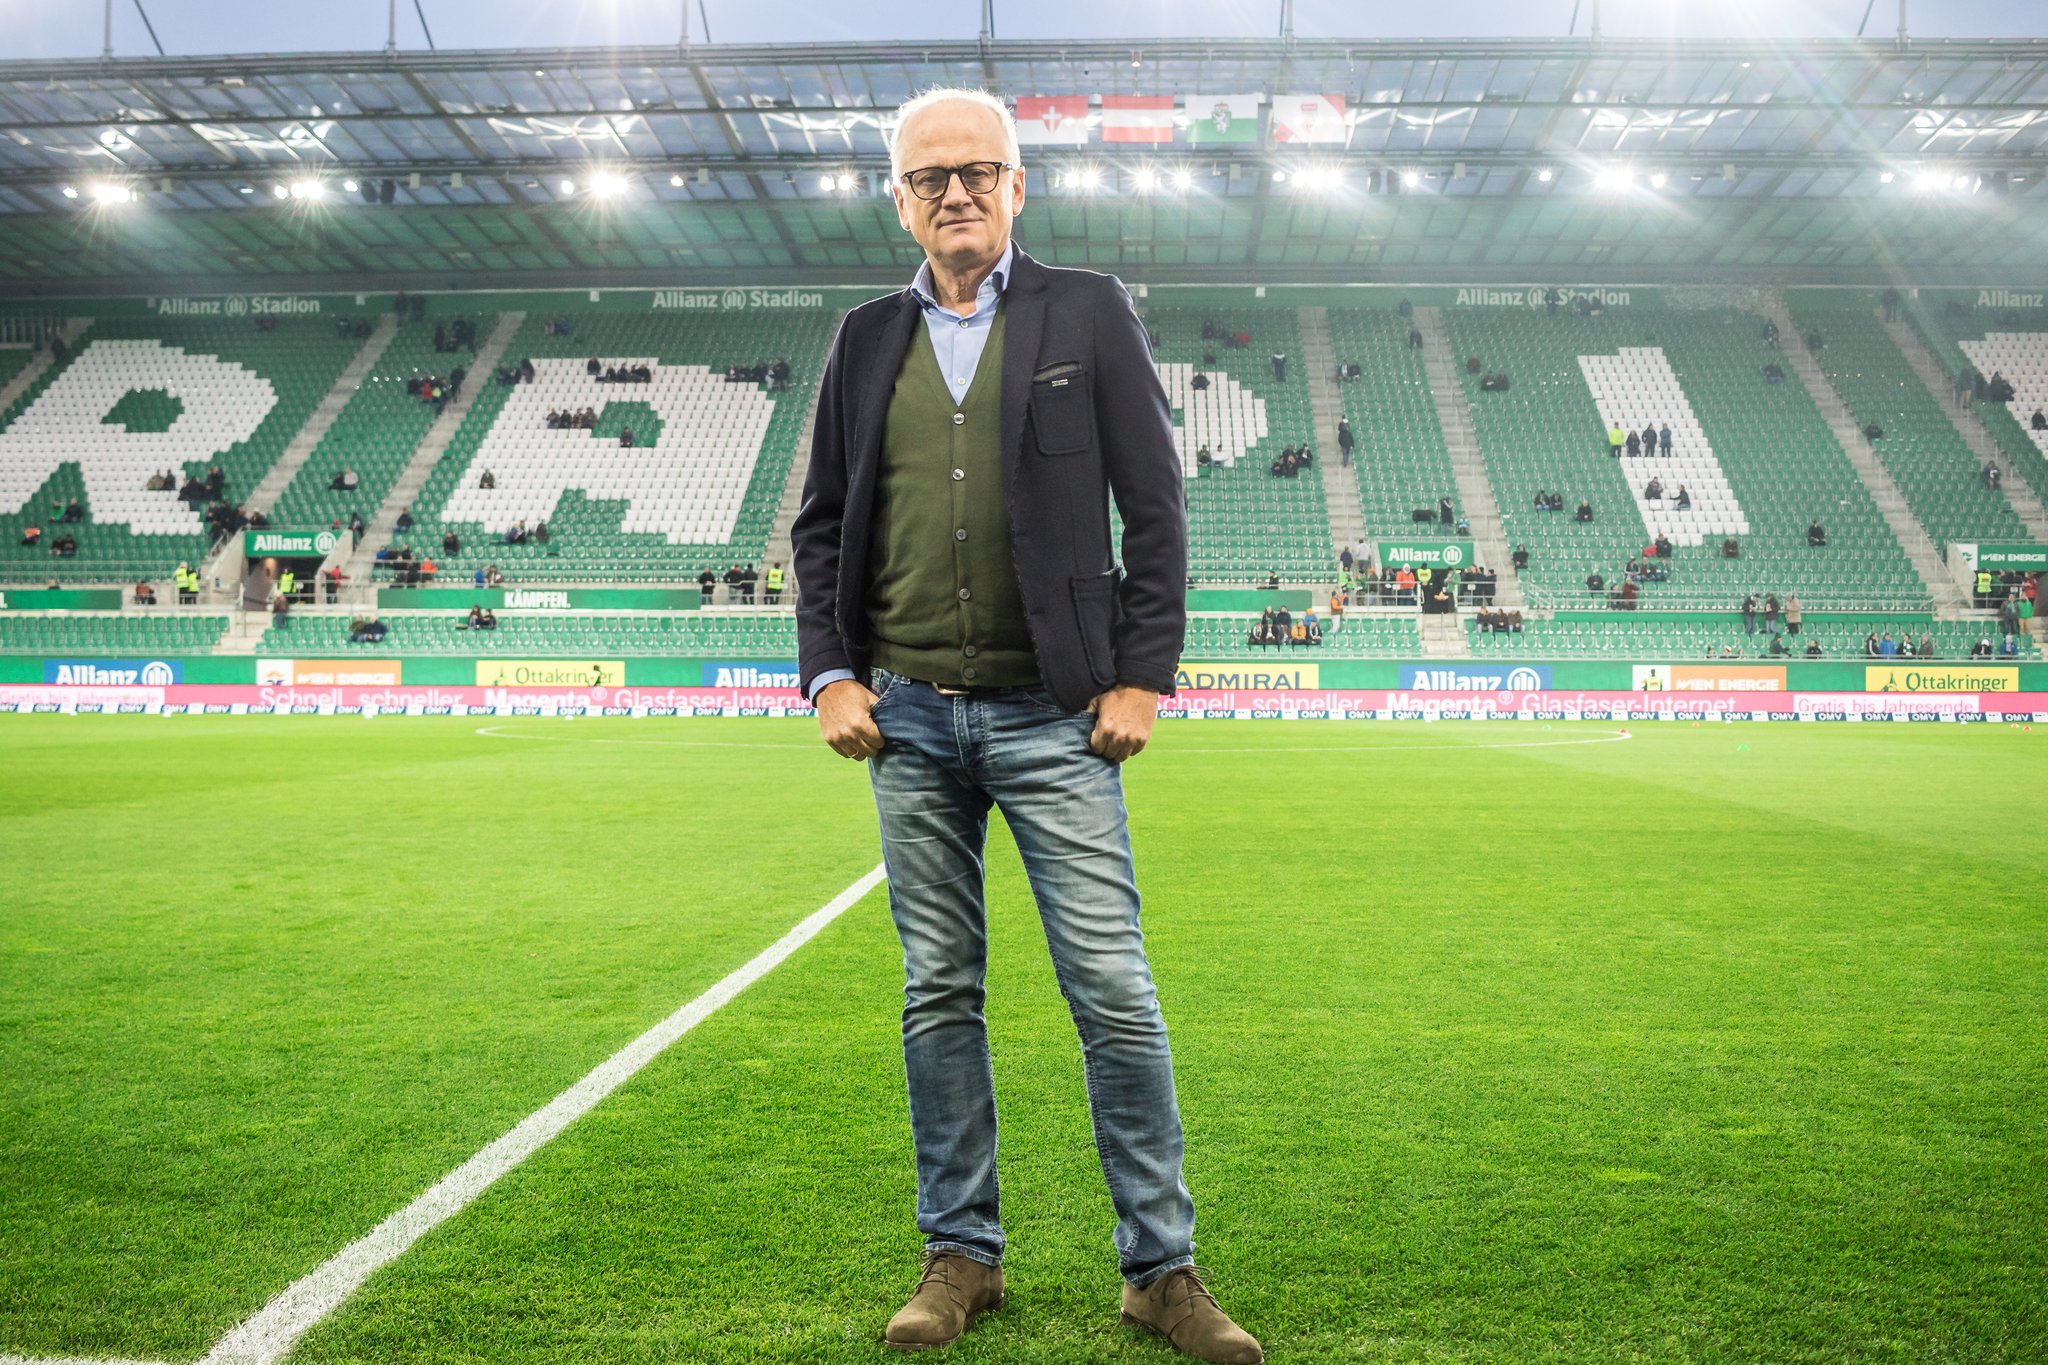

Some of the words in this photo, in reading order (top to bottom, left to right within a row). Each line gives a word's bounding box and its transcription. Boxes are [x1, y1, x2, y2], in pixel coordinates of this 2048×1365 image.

[158, 298, 221, 315] Allianz
[251, 297, 320, 314] Stadion
[652, 291, 718, 309] Allianz
[750, 289, 823, 308] Stadion
[1456, 288, 1523, 306] Allianz
[1977, 290, 2044, 308] Allianz
[253, 534, 312, 551] Allianz
[1388, 548, 1440, 562] Allianz
[1980, 553, 2005, 562] WIEN
[56, 664, 138, 685] Allianz
[515, 666, 614, 685] Ottakriner
[714, 667, 799, 688] Allianz
[1175, 670, 1313, 690] ADMIRAL
[1412, 670, 1503, 691] Allianz
[1905, 672, 2008, 692] Ottakringer
[1676, 679, 1714, 691] WIEN
[1718, 679, 1779, 691] ENERGIE
[259, 687, 342, 706] Schnell
[359, 688, 463, 706] schneller
[1252, 692, 1363, 711] schneller
[1521, 691, 1736, 713] Glasfaser-Internet
[1798, 698, 1846, 714] Gratis
[1852, 698, 1875, 714] bis
[1882, 698, 1973, 714] Jahresende
